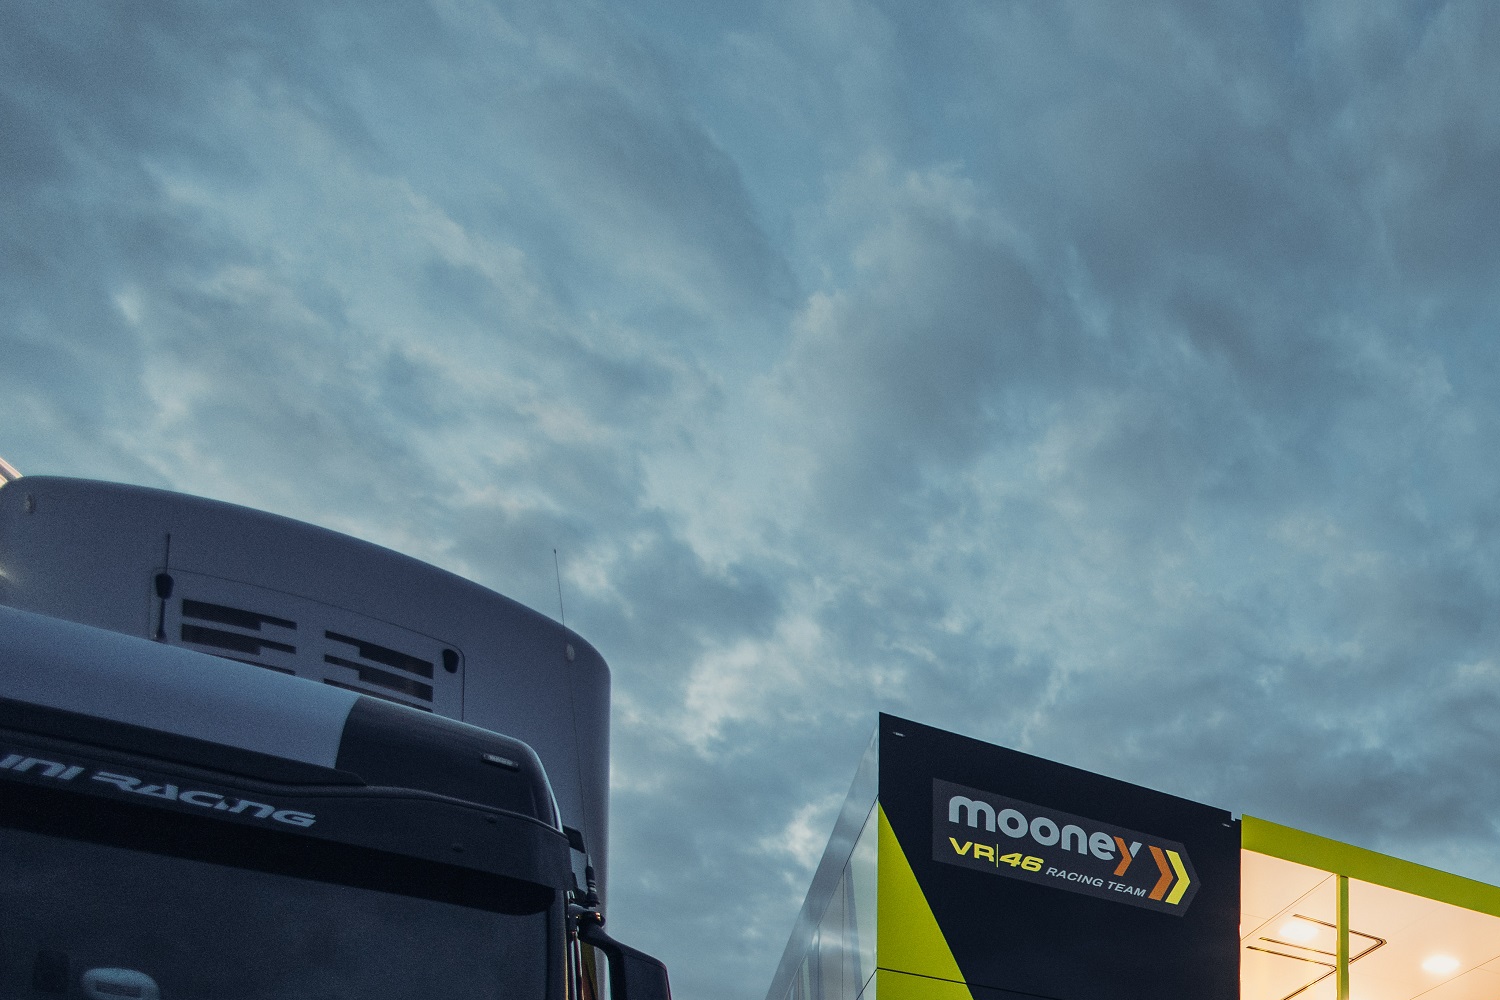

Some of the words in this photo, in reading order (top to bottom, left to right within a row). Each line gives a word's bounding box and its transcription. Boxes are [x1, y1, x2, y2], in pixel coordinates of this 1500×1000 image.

[92, 771, 318, 828] RACING
[949, 796, 1142, 877] mooney
[1046, 867, 1104, 888] RACING
[1107, 881, 1147, 898] TEAM
